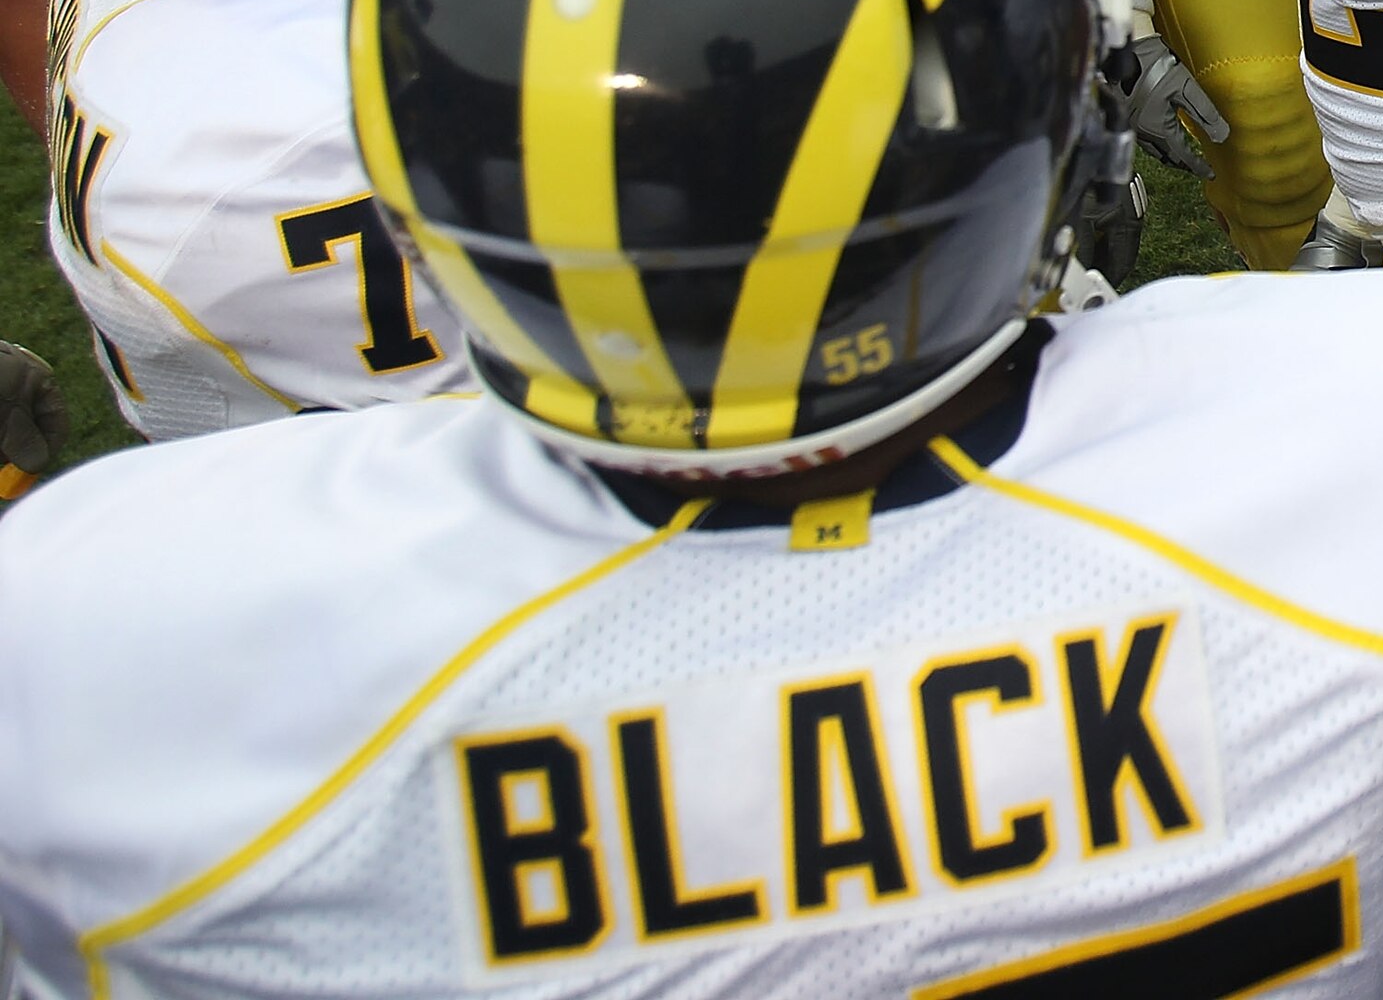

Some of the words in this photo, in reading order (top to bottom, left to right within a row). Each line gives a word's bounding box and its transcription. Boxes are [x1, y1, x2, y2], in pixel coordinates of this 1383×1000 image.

[821, 321, 894, 386] 55
[815, 525, 843, 544] M
[452, 611, 1203, 968] BLACK
